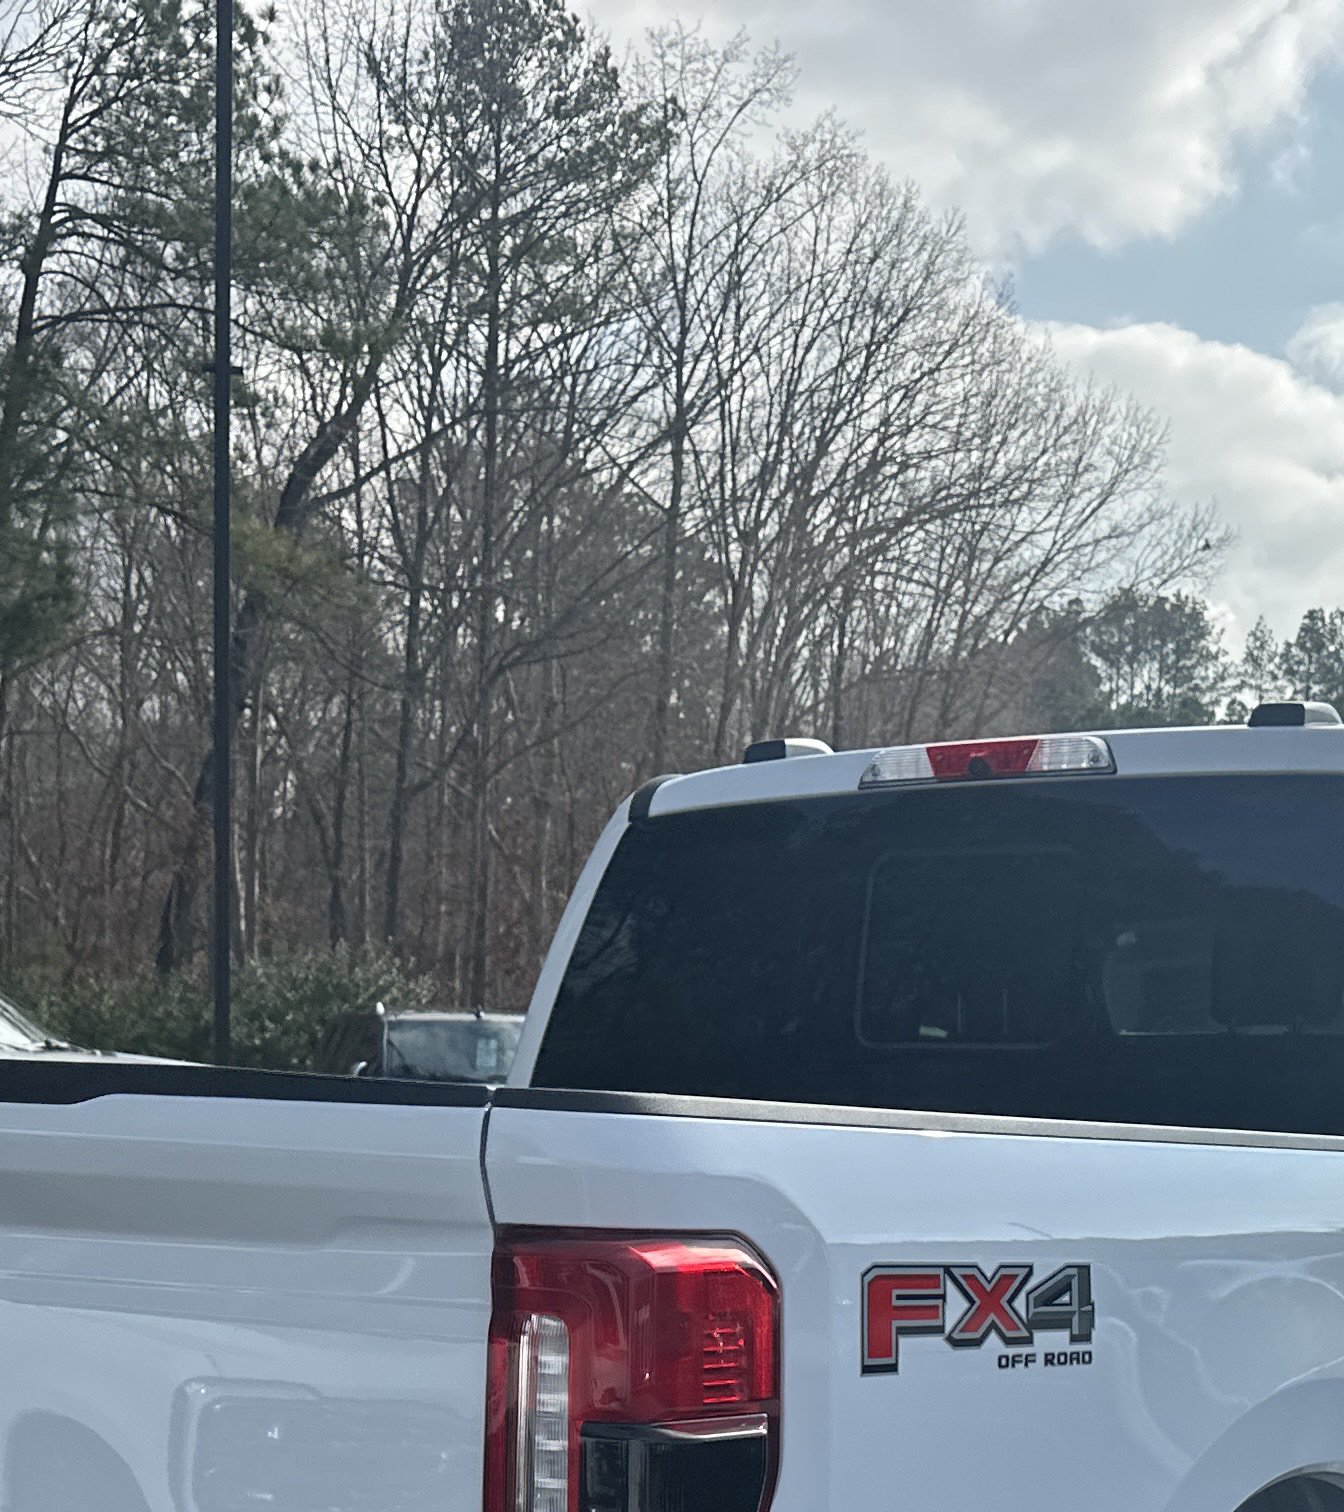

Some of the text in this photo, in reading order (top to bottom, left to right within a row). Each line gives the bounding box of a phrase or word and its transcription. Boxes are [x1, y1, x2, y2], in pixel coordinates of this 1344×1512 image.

[860, 1262, 1094, 1377] FX4
[997, 1350, 1093, 1370] OFF ROAD
